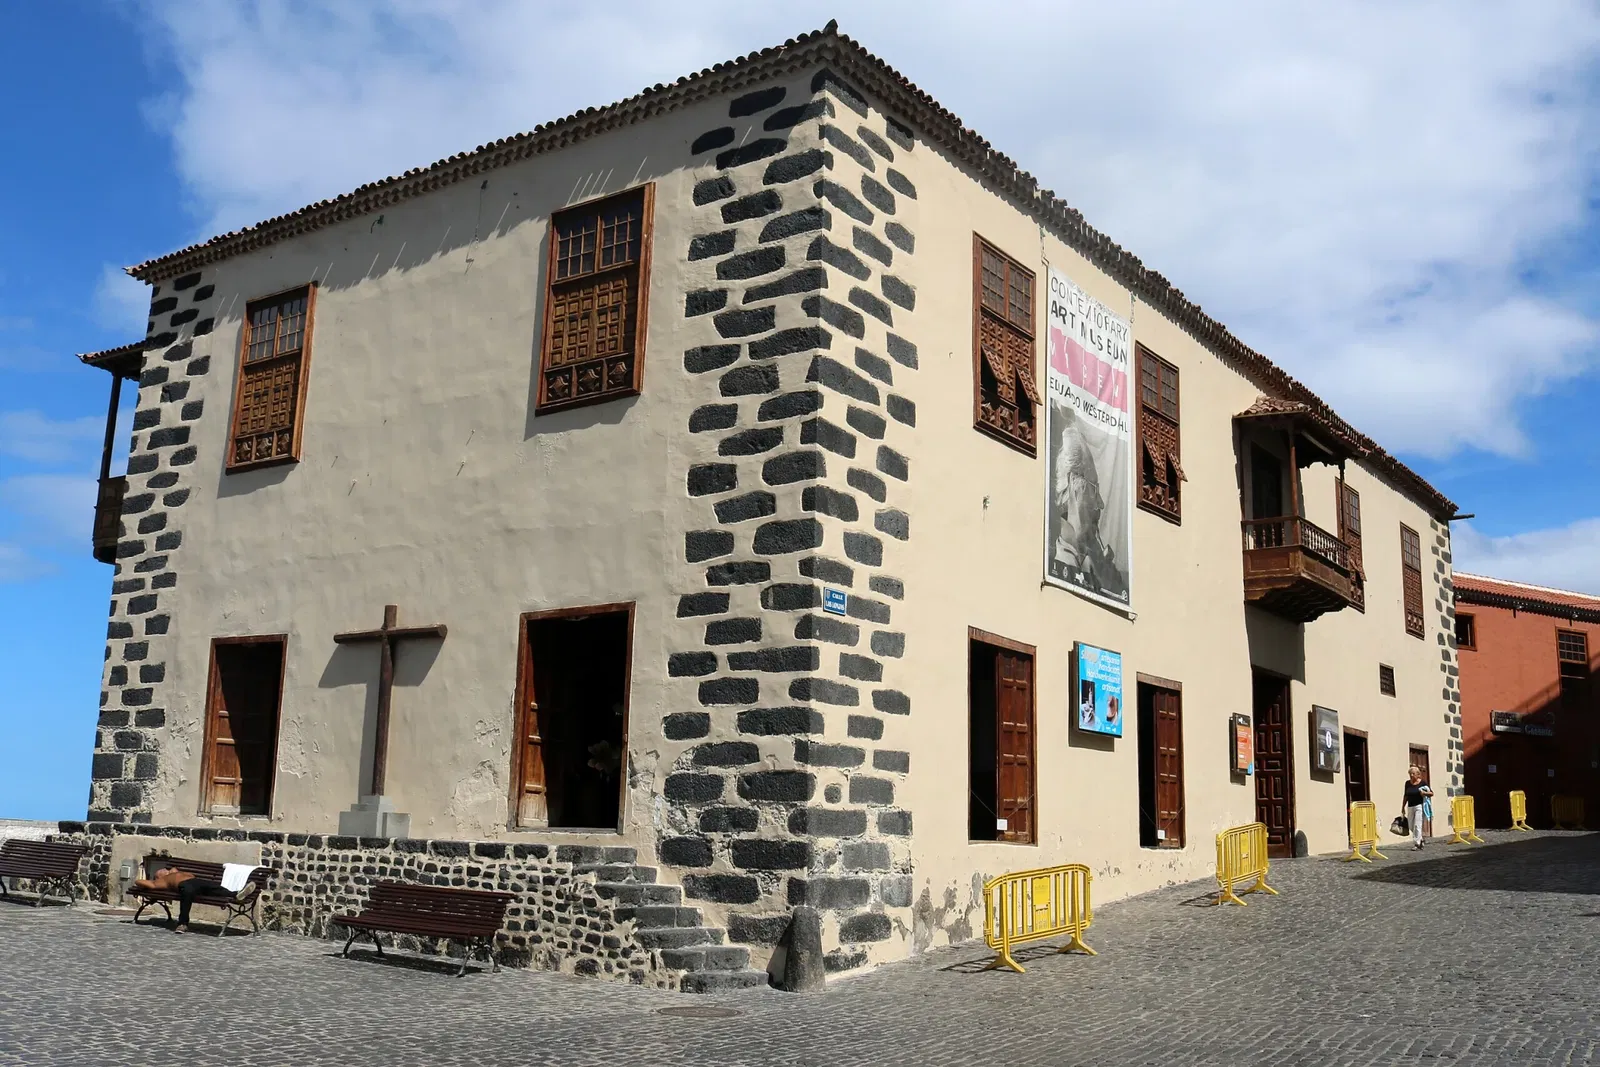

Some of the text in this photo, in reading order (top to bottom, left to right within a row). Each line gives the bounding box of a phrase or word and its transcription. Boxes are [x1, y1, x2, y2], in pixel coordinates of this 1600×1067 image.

[1050, 300, 1076, 328] ART
[1050, 376, 1128, 433] EUAO WESTERDHL
